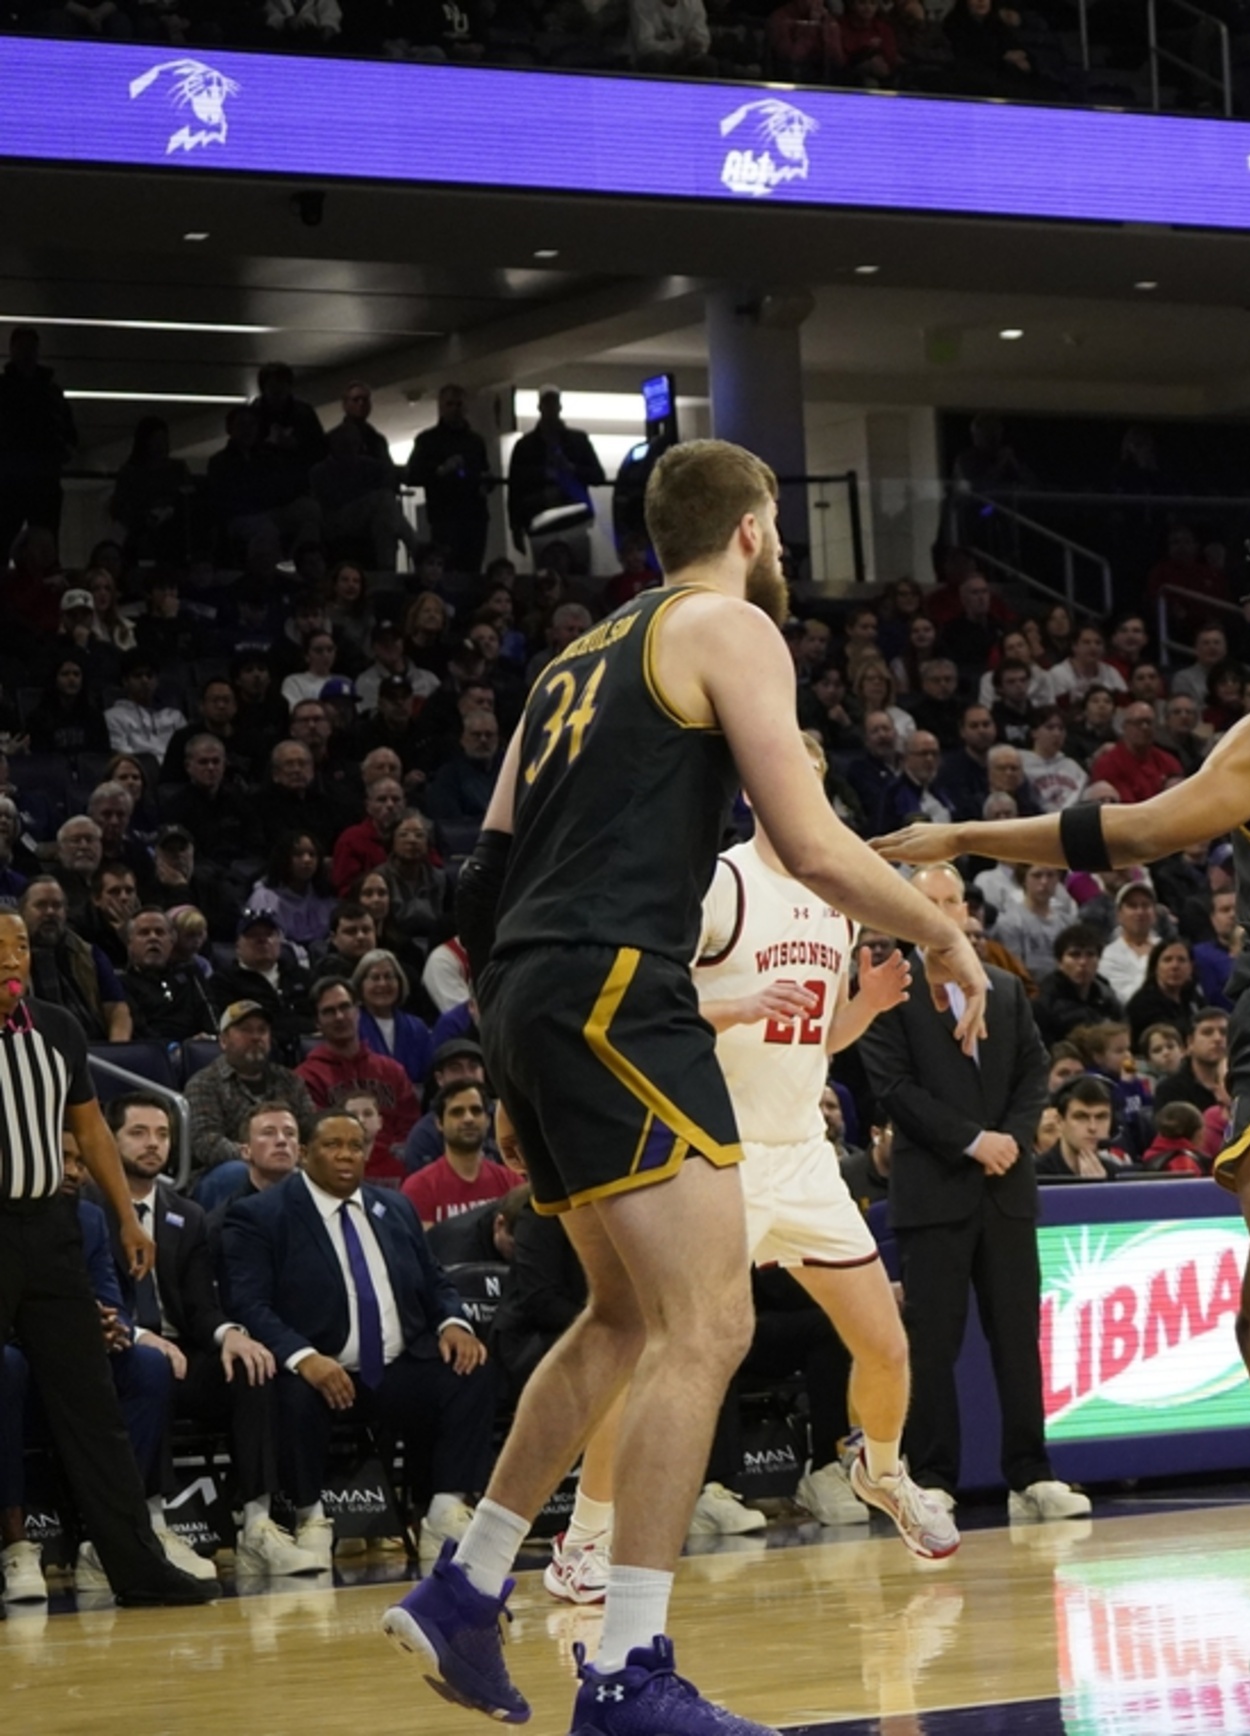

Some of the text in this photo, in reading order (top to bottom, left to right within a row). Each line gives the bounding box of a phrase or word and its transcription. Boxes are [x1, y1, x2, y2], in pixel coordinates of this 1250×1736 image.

[525, 656, 607, 786] 34
[754, 940, 843, 974] WISCONSIN
[483, 1275, 502, 1297] N
[1039, 1246, 1244, 1416] LIBMA
